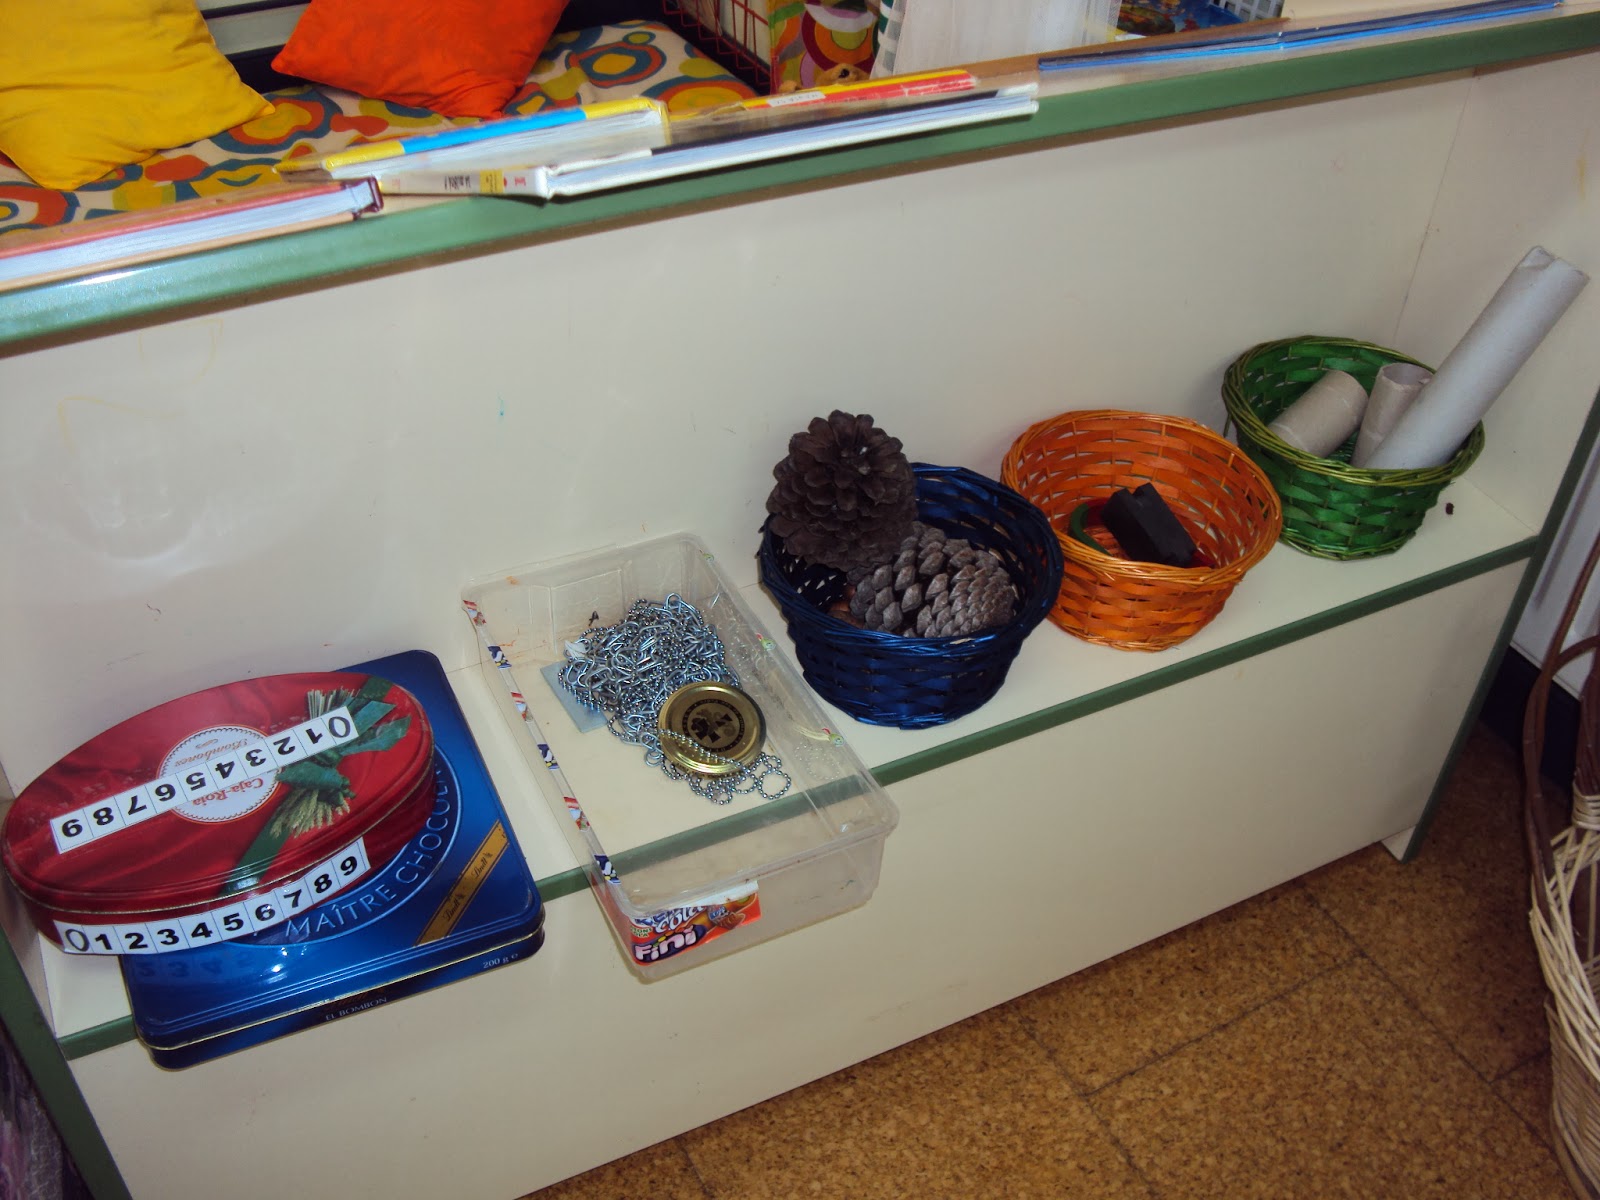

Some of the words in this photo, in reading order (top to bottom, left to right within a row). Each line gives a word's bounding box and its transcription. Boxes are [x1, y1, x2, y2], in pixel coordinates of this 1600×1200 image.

[305, 728, 323, 745] 1
[328, 715, 351, 739] 0
[272, 736, 296, 755] 2
[245, 748, 267, 767] 3
[214, 760, 236, 779] 4
[185, 772, 206, 791] 5
[154, 783, 176, 802] 6
[127, 795, 148, 815] 7
[92, 806, 115, 826] 8
[61, 818, 83, 838] 9
[65, 928, 90, 952] 0
[94, 934, 113, 950] 1
[124, 932, 148, 950] 2
[156, 928, 180, 946] 3
[190, 922, 213, 939] 4
[223, 912, 244, 931] 5
[255, 903, 276, 922] 6
[283, 889, 303, 908] 7
[313, 874, 333, 893] 8
[340, 856, 358, 876] 9
[285, 884, 397, 938] MAÎTRE
[634, 925, 697, 961] Fini
[482, 957, 501, 970] 200
[339, 997, 387, 1017] BOMBON
